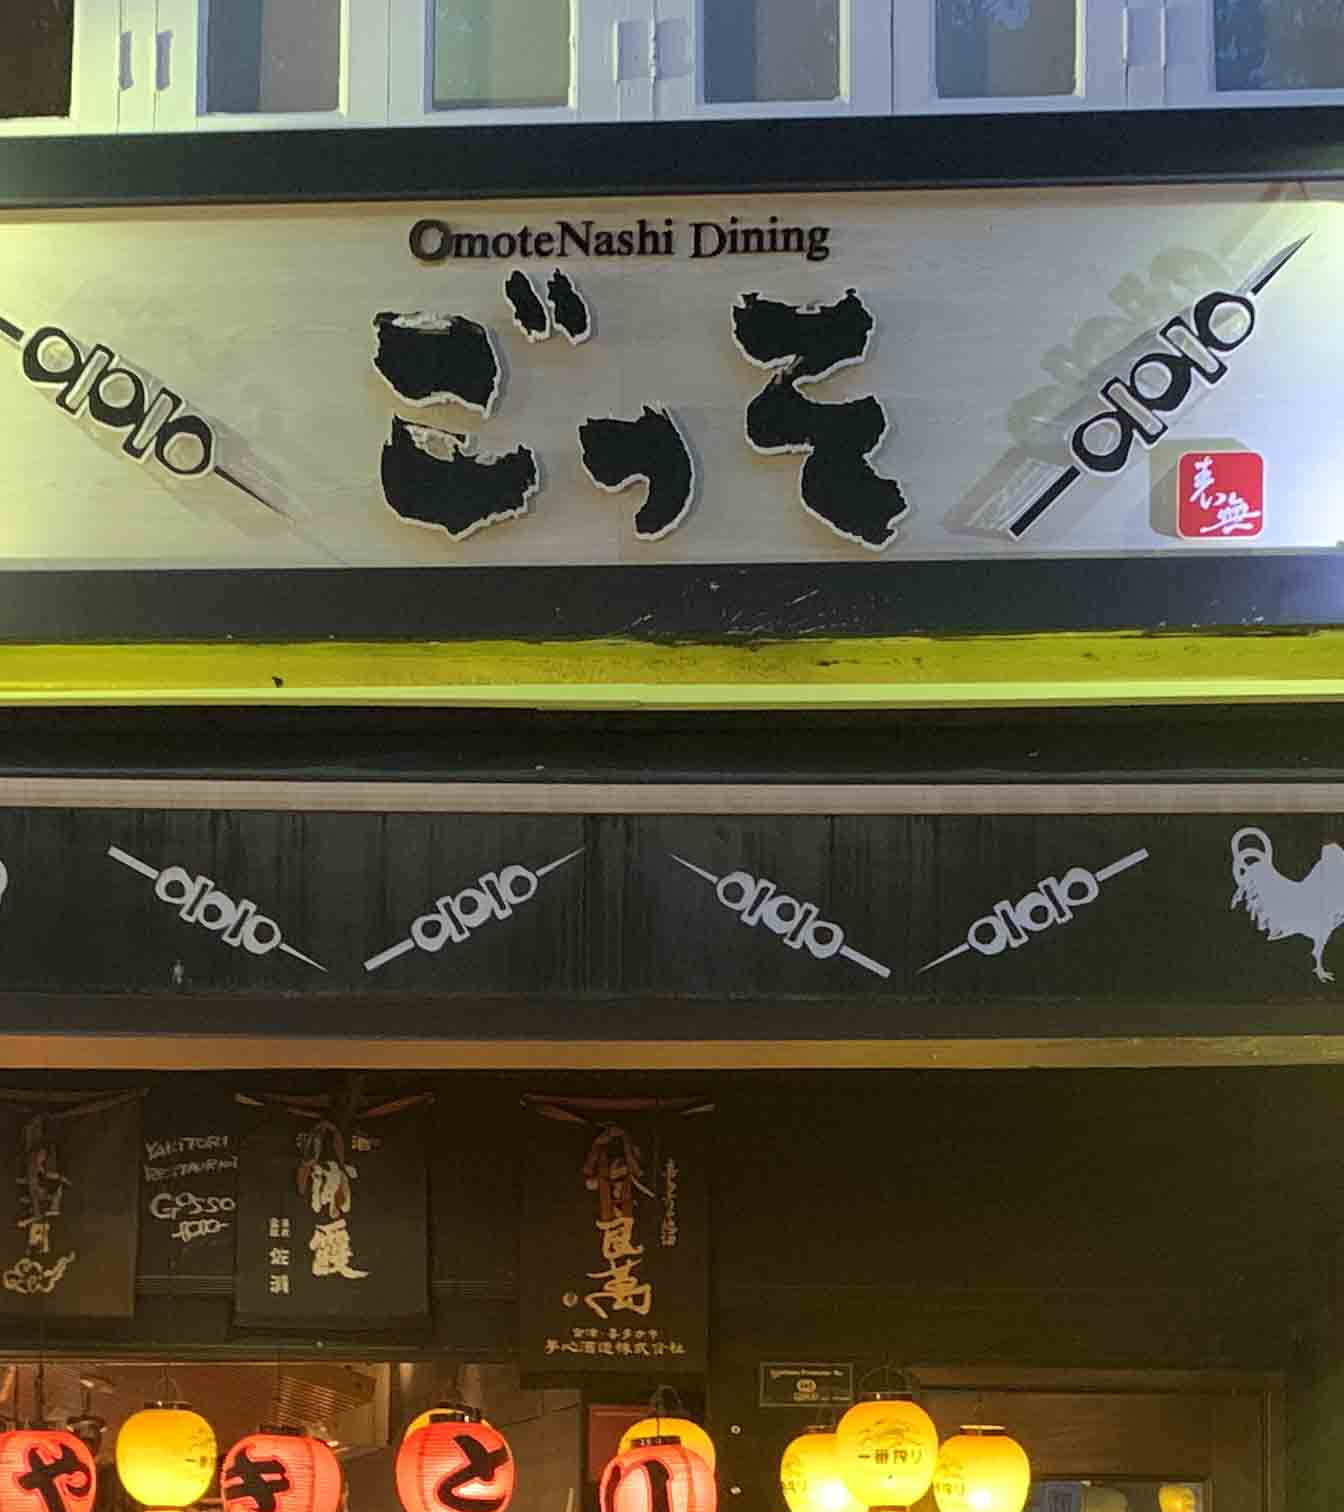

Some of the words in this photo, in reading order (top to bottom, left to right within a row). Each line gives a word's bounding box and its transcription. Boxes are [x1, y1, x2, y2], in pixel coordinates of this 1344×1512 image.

[408, 216, 674, 263] OmoteNashi
[689, 214, 830, 263] Dining
[372, 264, 911, 553] ごっそ
[150, 1192, 237, 1221] Gosso
